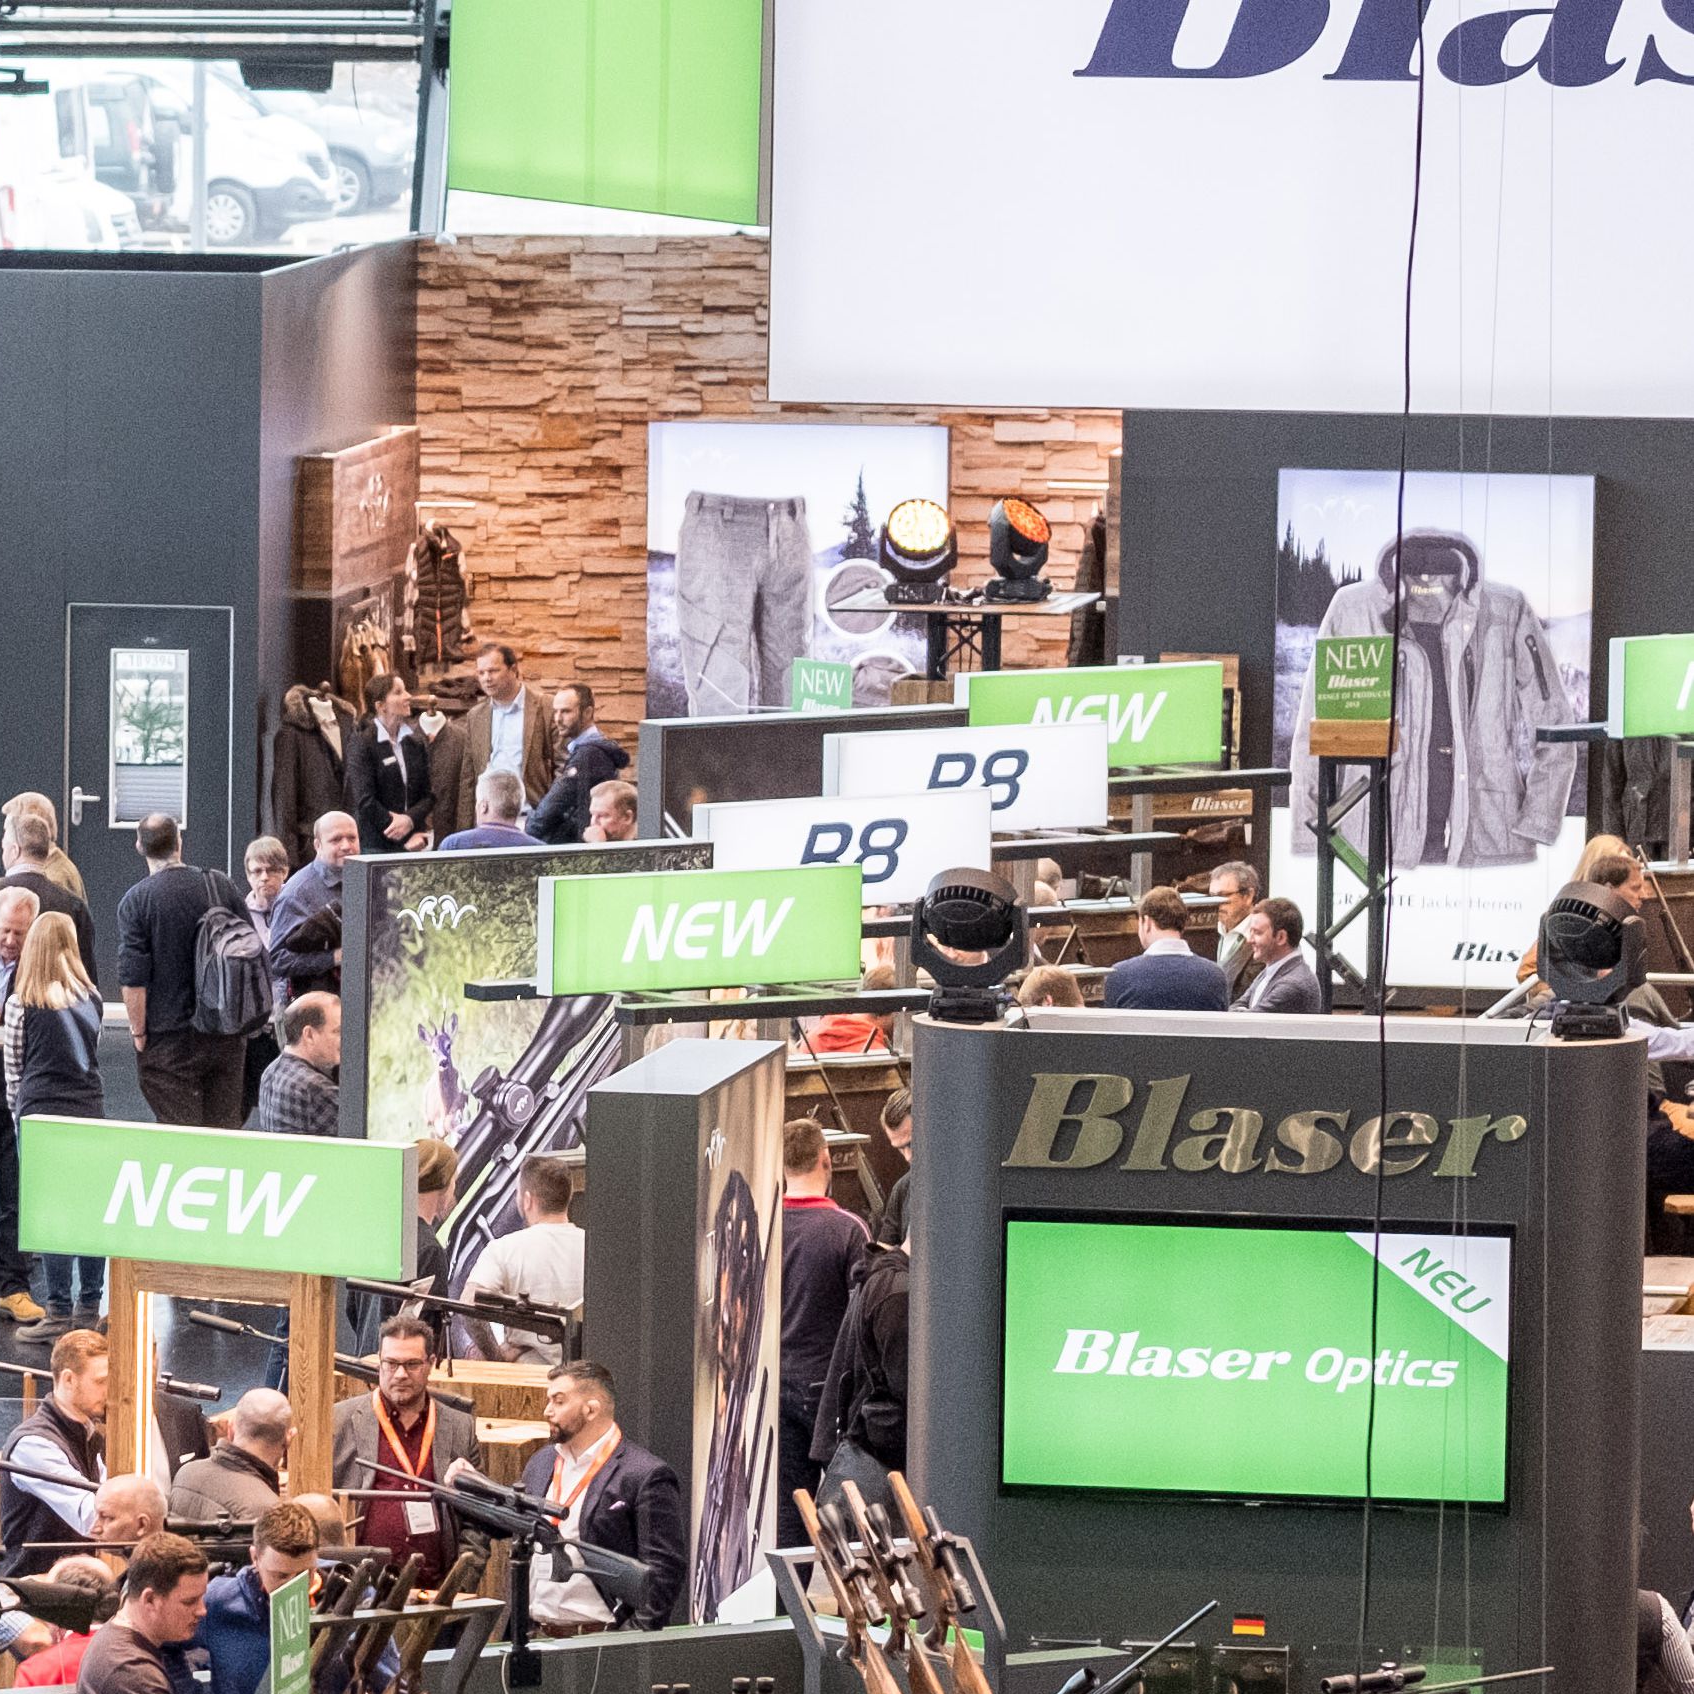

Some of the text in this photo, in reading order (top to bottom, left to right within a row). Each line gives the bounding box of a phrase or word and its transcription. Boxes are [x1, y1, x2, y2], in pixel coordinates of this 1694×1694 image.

[801, 668, 845, 697] NEW
[1325, 643, 1386, 670] NEW
[1327, 675, 1380, 689] Blaser
[1031, 691, 1167, 743] NEW
[1191, 796, 1250, 813] Blaser
[622, 897, 795, 964] NEW
[1451, 941, 1520, 963] Blas
[1003, 1072, 1528, 1178] Blaser
[104, 1160, 317, 1239] NEW
[1400, 1247, 1493, 1315] NEU
[1053, 1328, 1460, 1393] Blaser Optics
[278, 1590, 305, 1645] NEU
